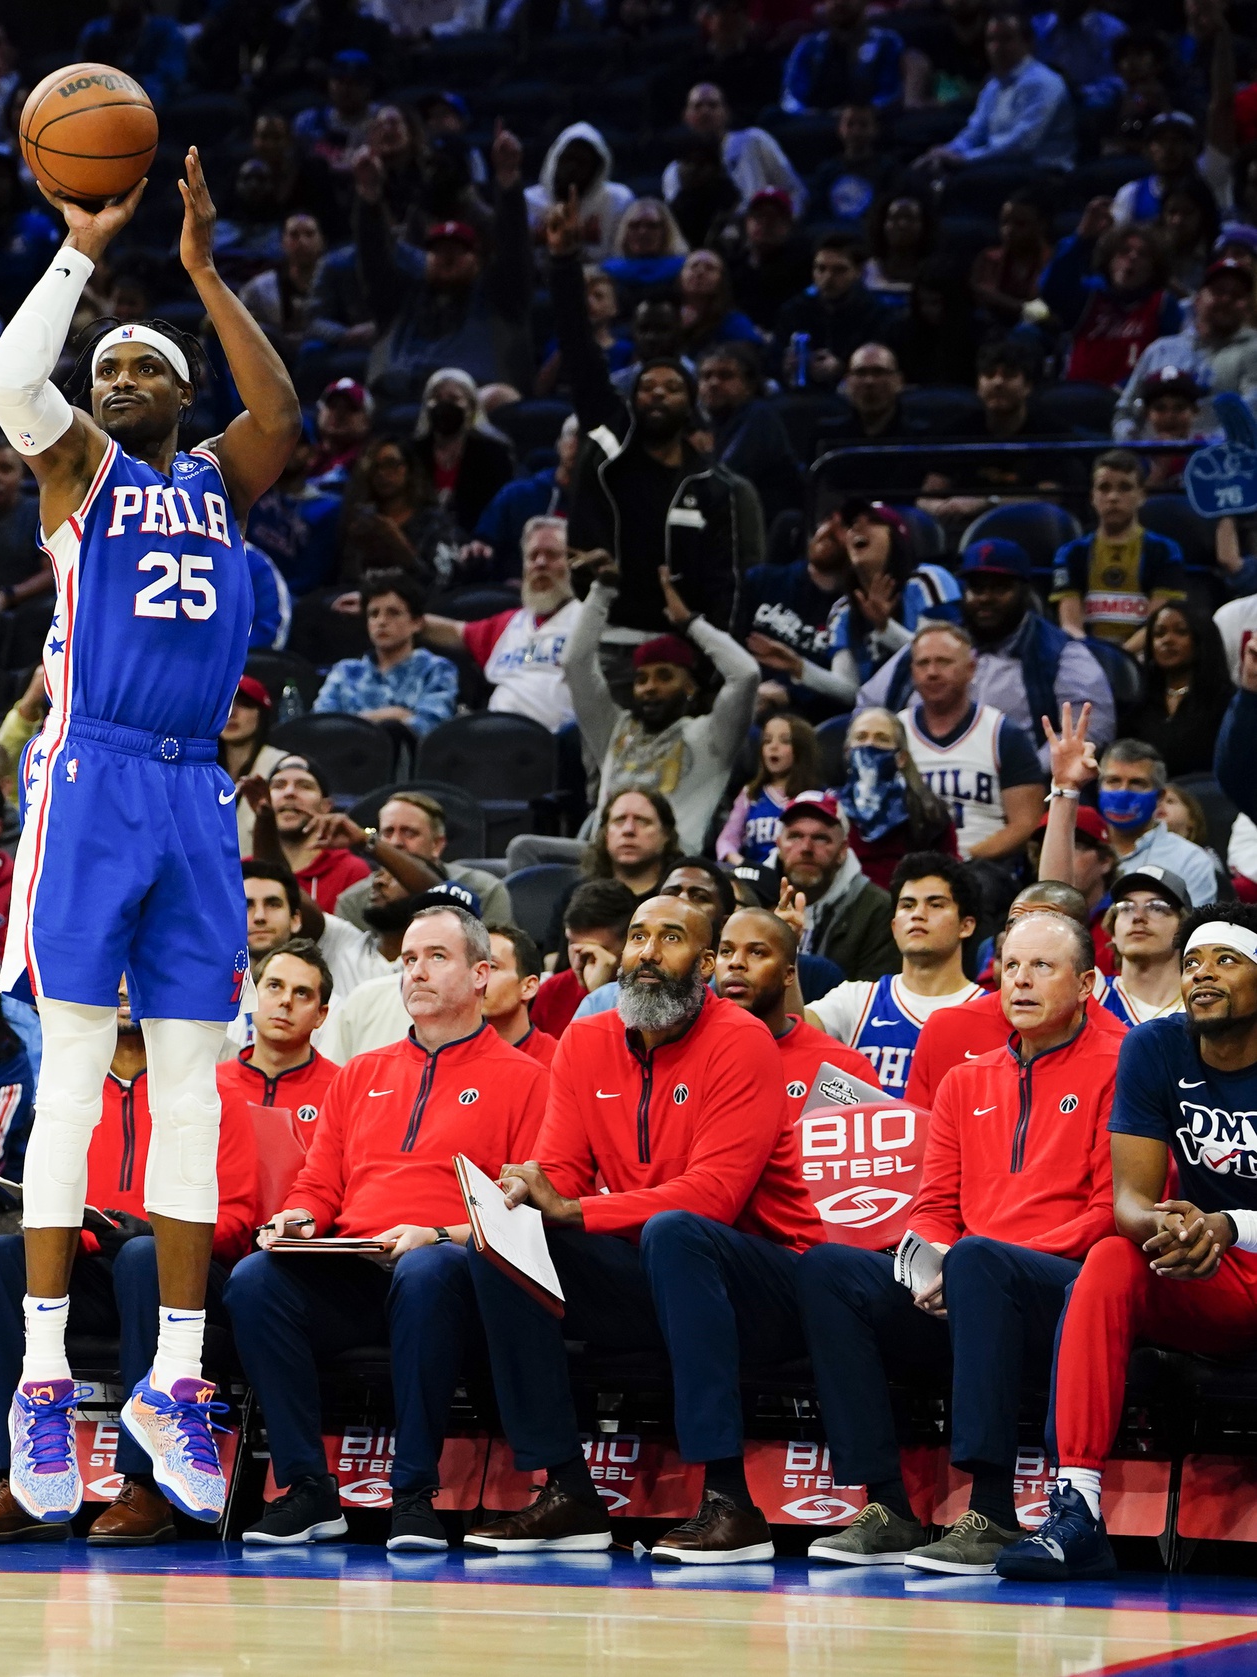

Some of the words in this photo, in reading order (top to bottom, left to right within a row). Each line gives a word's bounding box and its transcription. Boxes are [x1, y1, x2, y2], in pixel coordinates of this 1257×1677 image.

[57, 74, 146, 98] Wilson
[177, 465, 214, 481] crypto.com
[106, 485, 232, 549] PHILA
[133, 550, 217, 621] 25
[802, 1109, 916, 1157] BIO
[802, 1155, 916, 1181] STEEL
[338, 1458, 393, 1473] STEE
[785, 1441, 830, 1471] BI
